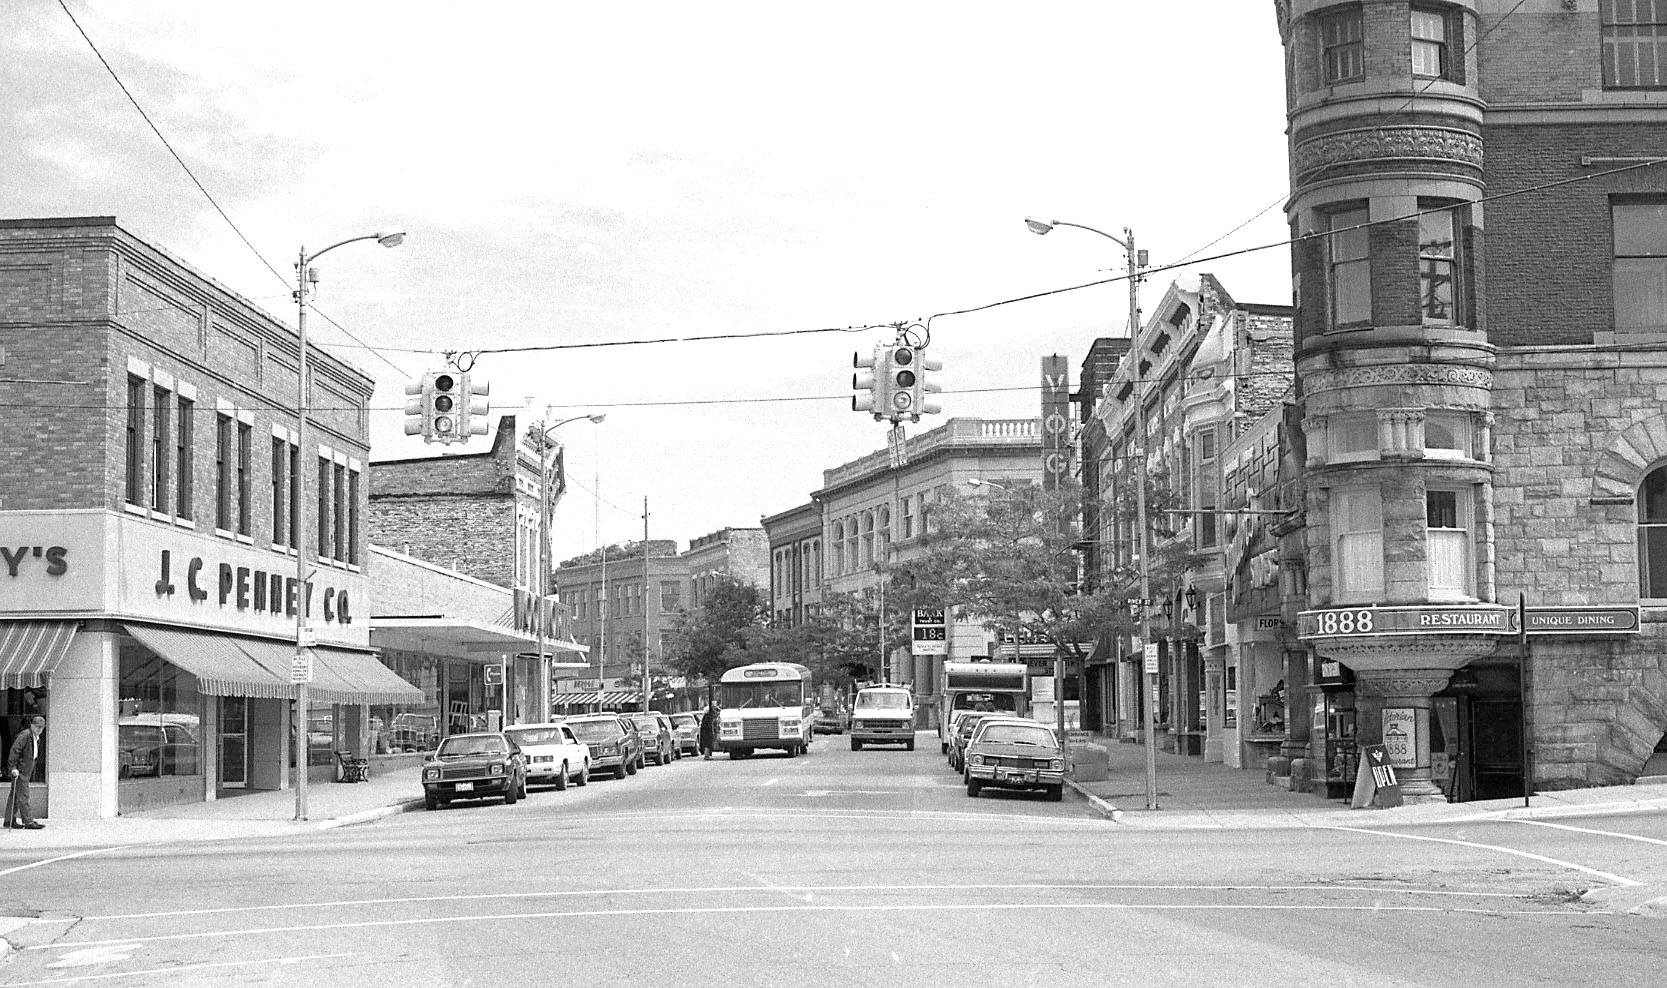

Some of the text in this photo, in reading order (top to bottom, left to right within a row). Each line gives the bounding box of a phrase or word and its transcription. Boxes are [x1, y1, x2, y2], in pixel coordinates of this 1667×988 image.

[0, 546, 68, 577] Y'S
[155, 550, 175, 596] J.
[187, 556, 208, 602] C.
[1259, 618, 1280, 629] FLOR
[1316, 610, 1374, 635] 1888
[1420, 613, 1501, 626] RESTAURANT
[1531, 615, 1615, 626] UNIQUE DINING
[1372, 764, 1398, 788] OPEN
